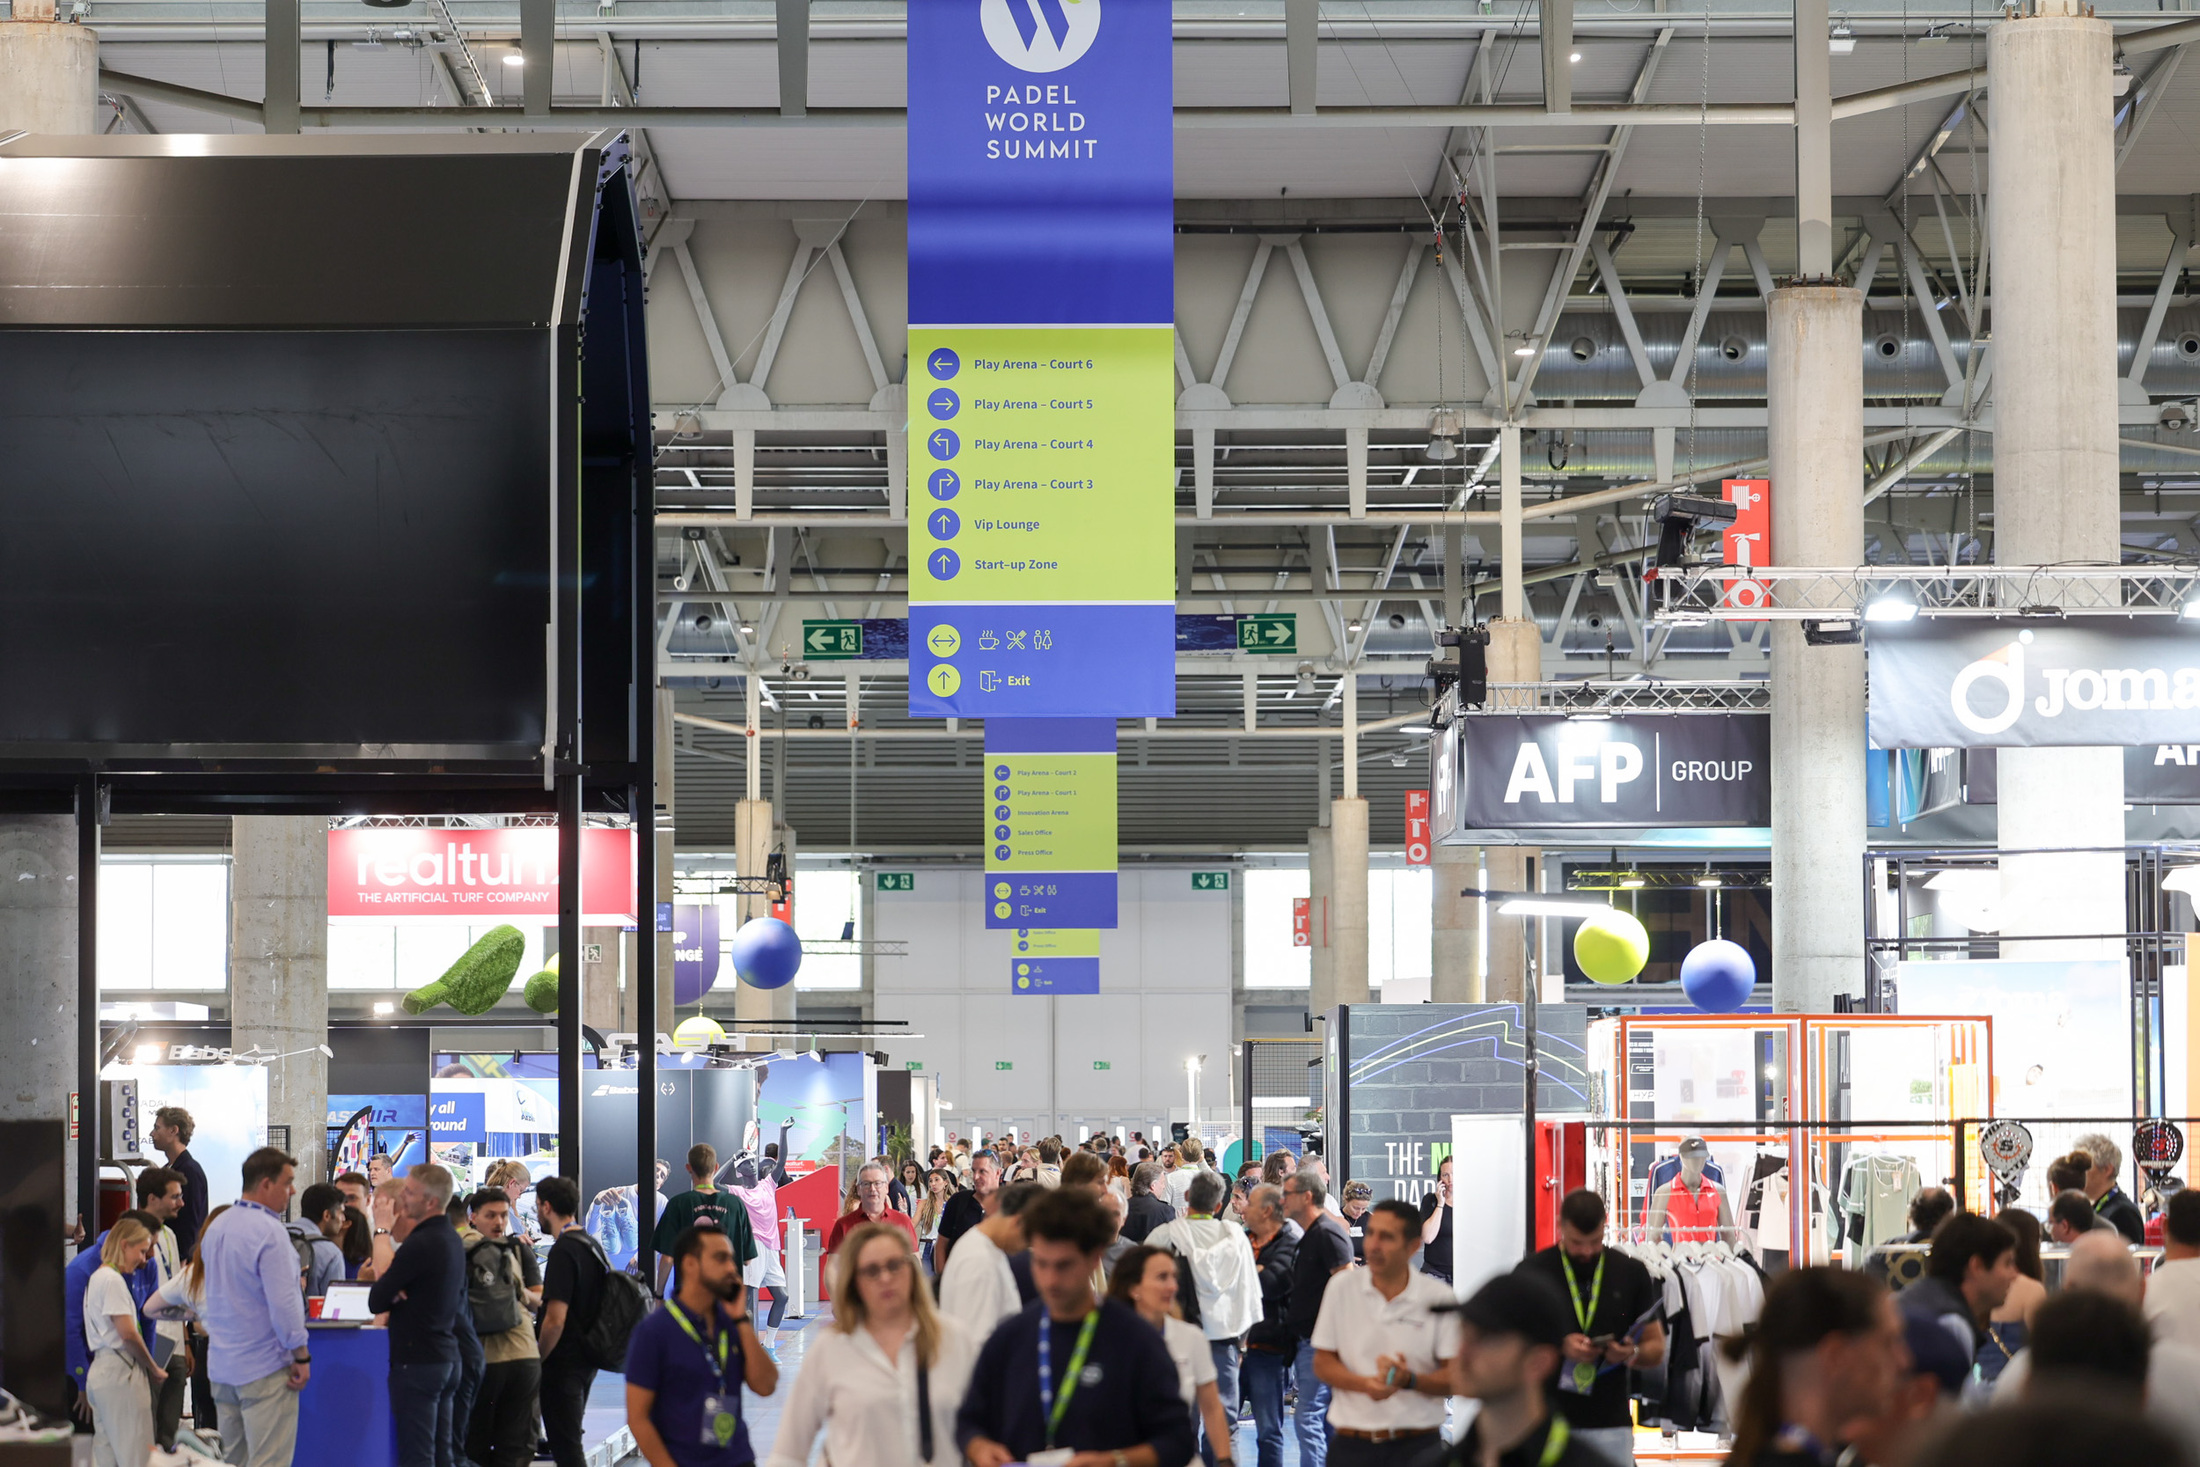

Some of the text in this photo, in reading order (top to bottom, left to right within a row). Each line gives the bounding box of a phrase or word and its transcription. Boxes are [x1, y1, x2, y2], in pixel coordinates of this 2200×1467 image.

[986, 85, 1077, 105] PADEL
[985, 112, 1086, 132] WORLD
[986, 139, 1098, 159] SUMMIT
[974, 359, 1001, 372] Play
[1003, 359, 1038, 370] Arena
[1050, 359, 1082, 370] Court
[1083, 359, 1093, 370] 6
[974, 399, 1001, 412] Play
[1003, 399, 1038, 410] Arena
[1050, 399, 1082, 410] Court
[1083, 399, 1093, 410] 5
[974, 439, 1001, 452] Play
[1003, 439, 1038, 450] Arena
[1050, 439, 1082, 450] Court
[1083, 439, 1093, 450] 4
[974, 479, 1001, 492] Play
[1003, 479, 1038, 490] Arena
[1050, 479, 1082, 490] Court
[1083, 479, 1093, 490] 3
[974, 519, 1040, 532] Vip Lounge
[1029, 559, 1058, 570] Zone
[1008, 676, 1031, 687] Exit
[1503, 742, 1753, 803] AFP GROUP
[357, 842, 559, 887] realtur
[357, 892, 550, 903] THE ARTIFICIAL TURF COMPANY
[438, 1100, 456, 1114] all
[1385, 1142, 1423, 1175] THE
